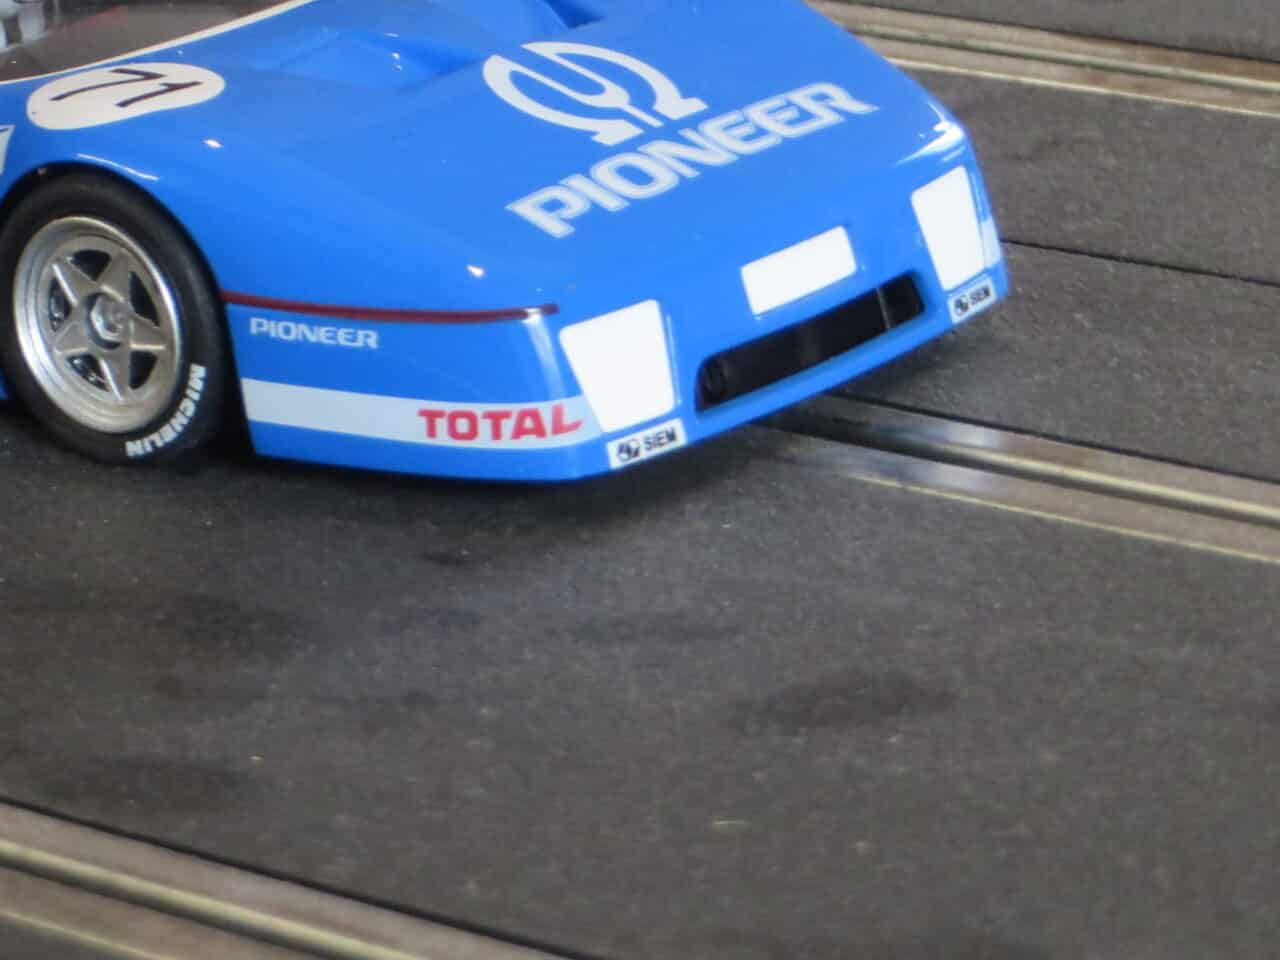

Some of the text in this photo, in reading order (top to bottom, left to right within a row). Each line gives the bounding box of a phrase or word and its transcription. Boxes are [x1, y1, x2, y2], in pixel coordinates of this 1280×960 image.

[505, 82, 880, 239] PIONEER
[249, 316, 379, 349] PIONEER
[125, 363, 207, 457] MICHELIN
[417, 402, 585, 441] TOTAL
